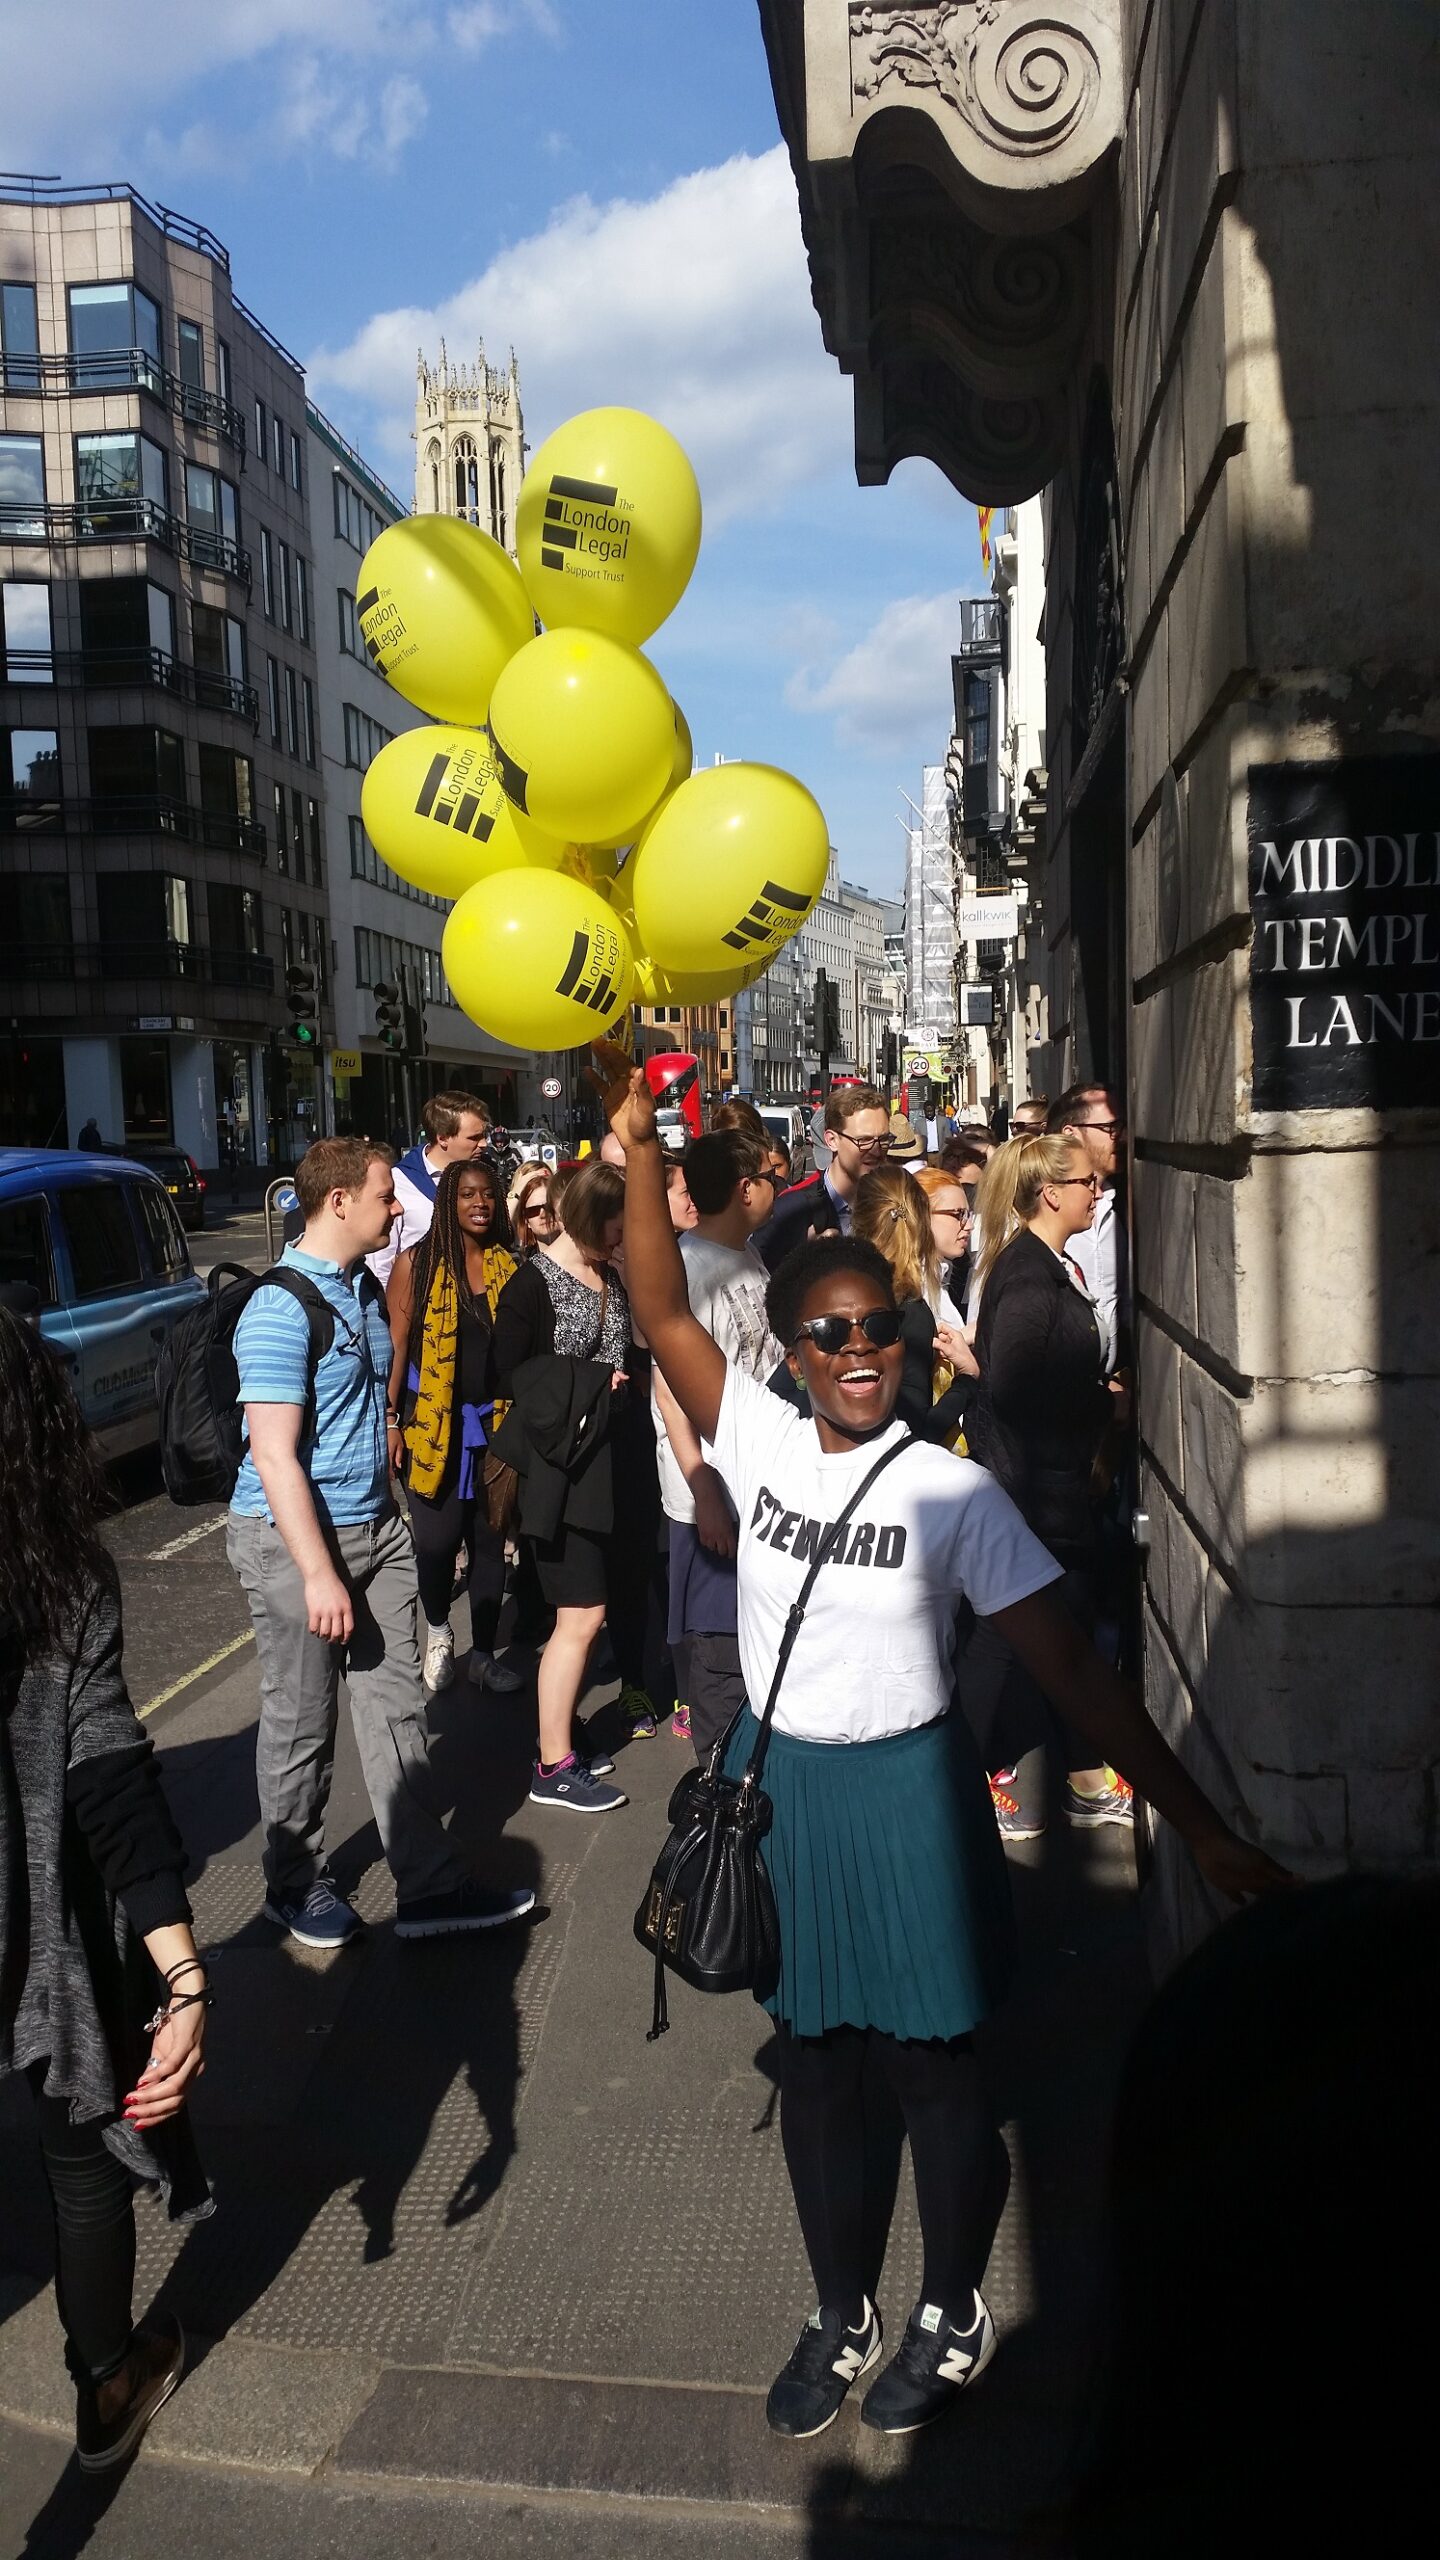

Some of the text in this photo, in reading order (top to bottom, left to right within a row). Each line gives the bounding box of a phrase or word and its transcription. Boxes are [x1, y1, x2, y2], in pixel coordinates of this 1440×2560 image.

[563, 502, 631, 535] London
[619, 498, 635, 511] The
[579, 531, 628, 561] Legal
[565, 562, 624, 582] Support Trust
[374, 616, 407, 650] Legal
[401, 643, 420, 658] Trust
[446, 743, 458, 754] The
[440, 748, 477, 805] London
[467, 754, 495, 796] Legal
[490, 790, 506, 817] Suppo
[1254, 831, 1440, 897] MIDDL
[582, 923, 605, 986] London
[603, 928, 619, 975] Legal
[1264, 912, 1440, 972] TEMPL
[1283, 990, 1440, 1048] LANE
[335, 1056, 356, 1068] itsu
[913, 1061, 927, 1070] 20
[546, 1083, 558, 1092] 20
[670, 1086, 678, 1094] 15
[750, 1486, 907, 1569] STEWARD
[831, 2345, 864, 2382] N
[936, 2347, 973, 2385] N
